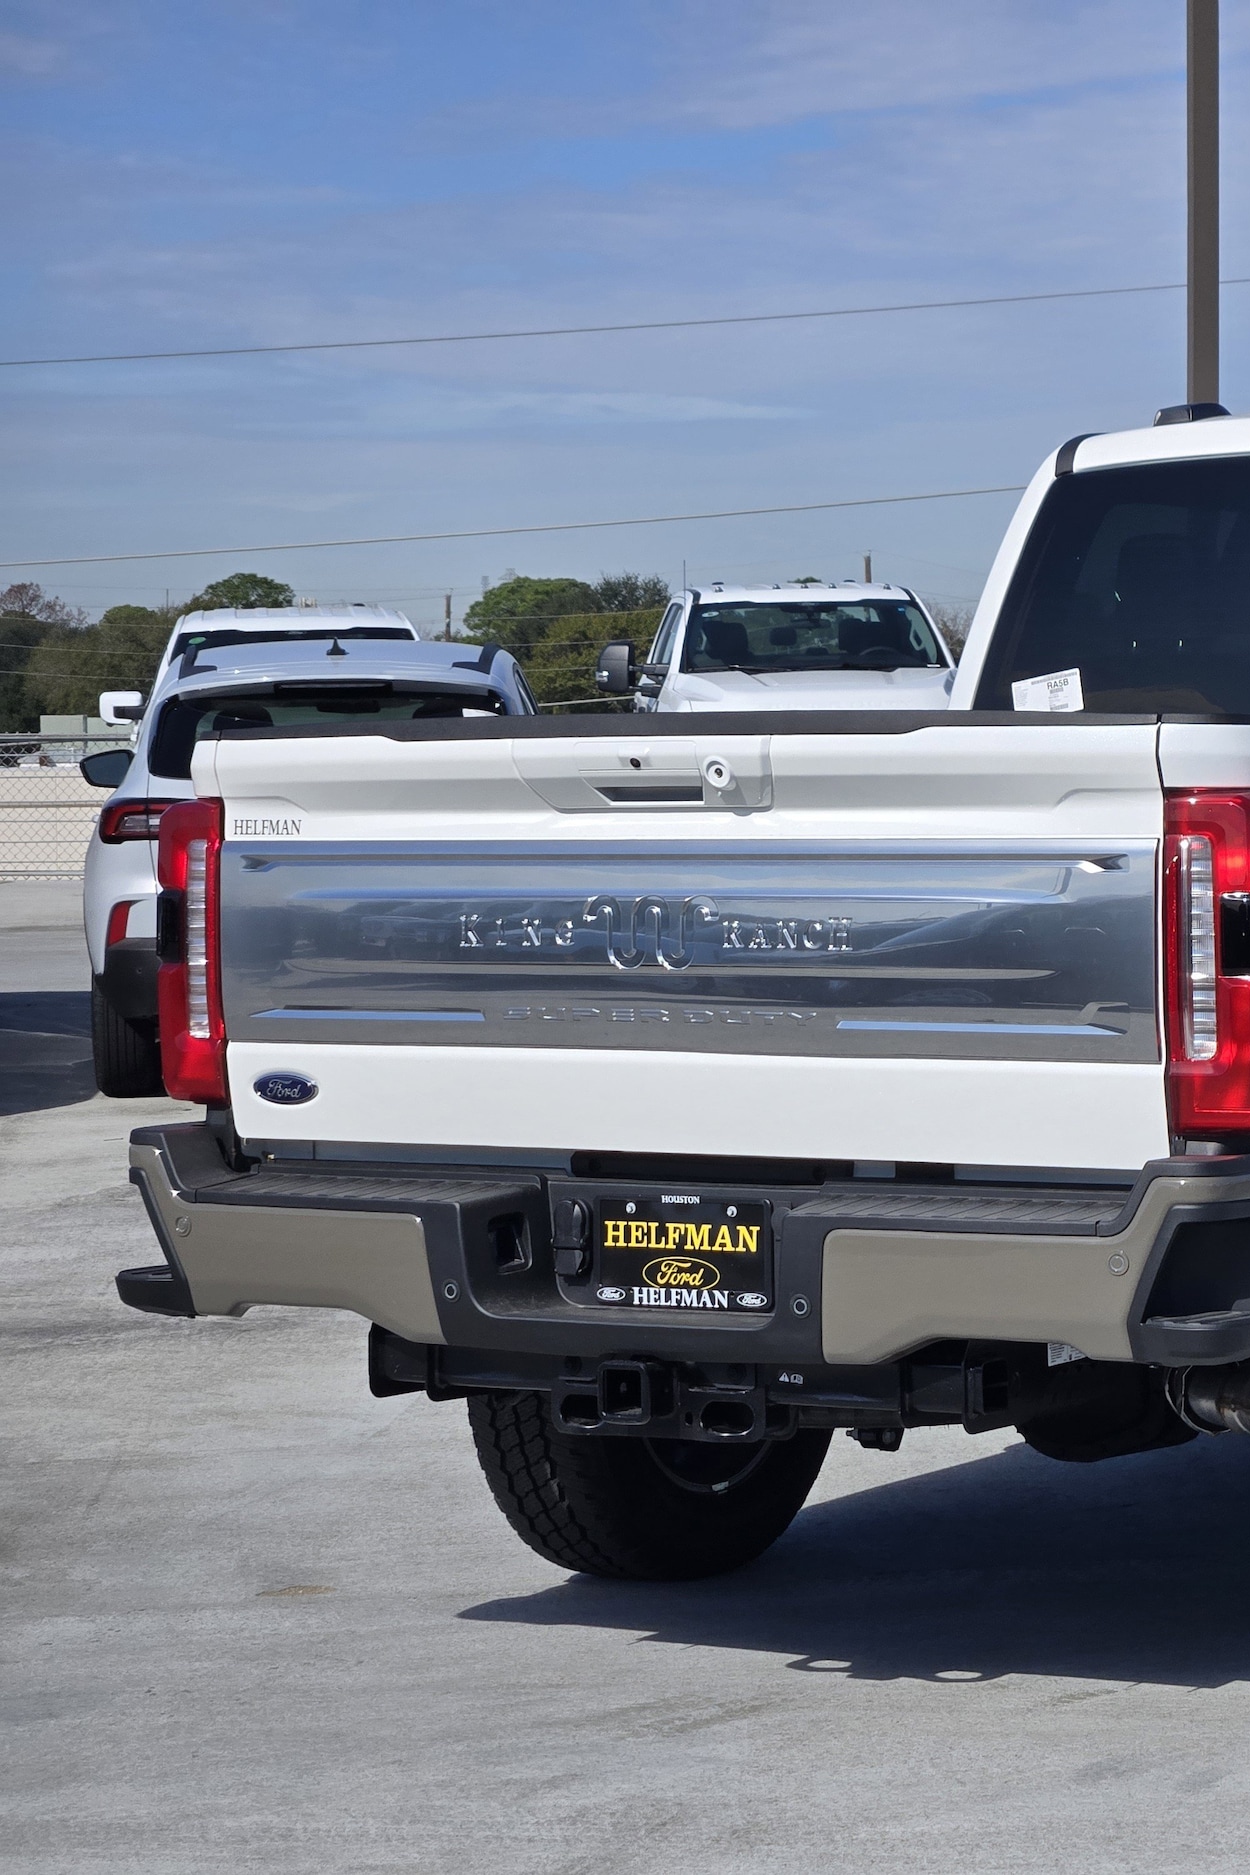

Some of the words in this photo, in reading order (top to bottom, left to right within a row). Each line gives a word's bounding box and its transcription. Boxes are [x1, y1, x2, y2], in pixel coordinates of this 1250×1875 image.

[234, 819, 302, 835] HELFMAN
[459, 914, 576, 947] KING
[722, 916, 853, 951] RANCH
[502, 1006, 670, 1023] SUPER
[683, 1010, 818, 1026] DUTY
[266, 1079, 301, 1098] Ford
[661, 1194, 700, 1204] HOUSTON
[604, 1220, 761, 1253] HELFMAN
[656, 1260, 705, 1286] Ford
[632, 1286, 729, 1308] HELFMAN
